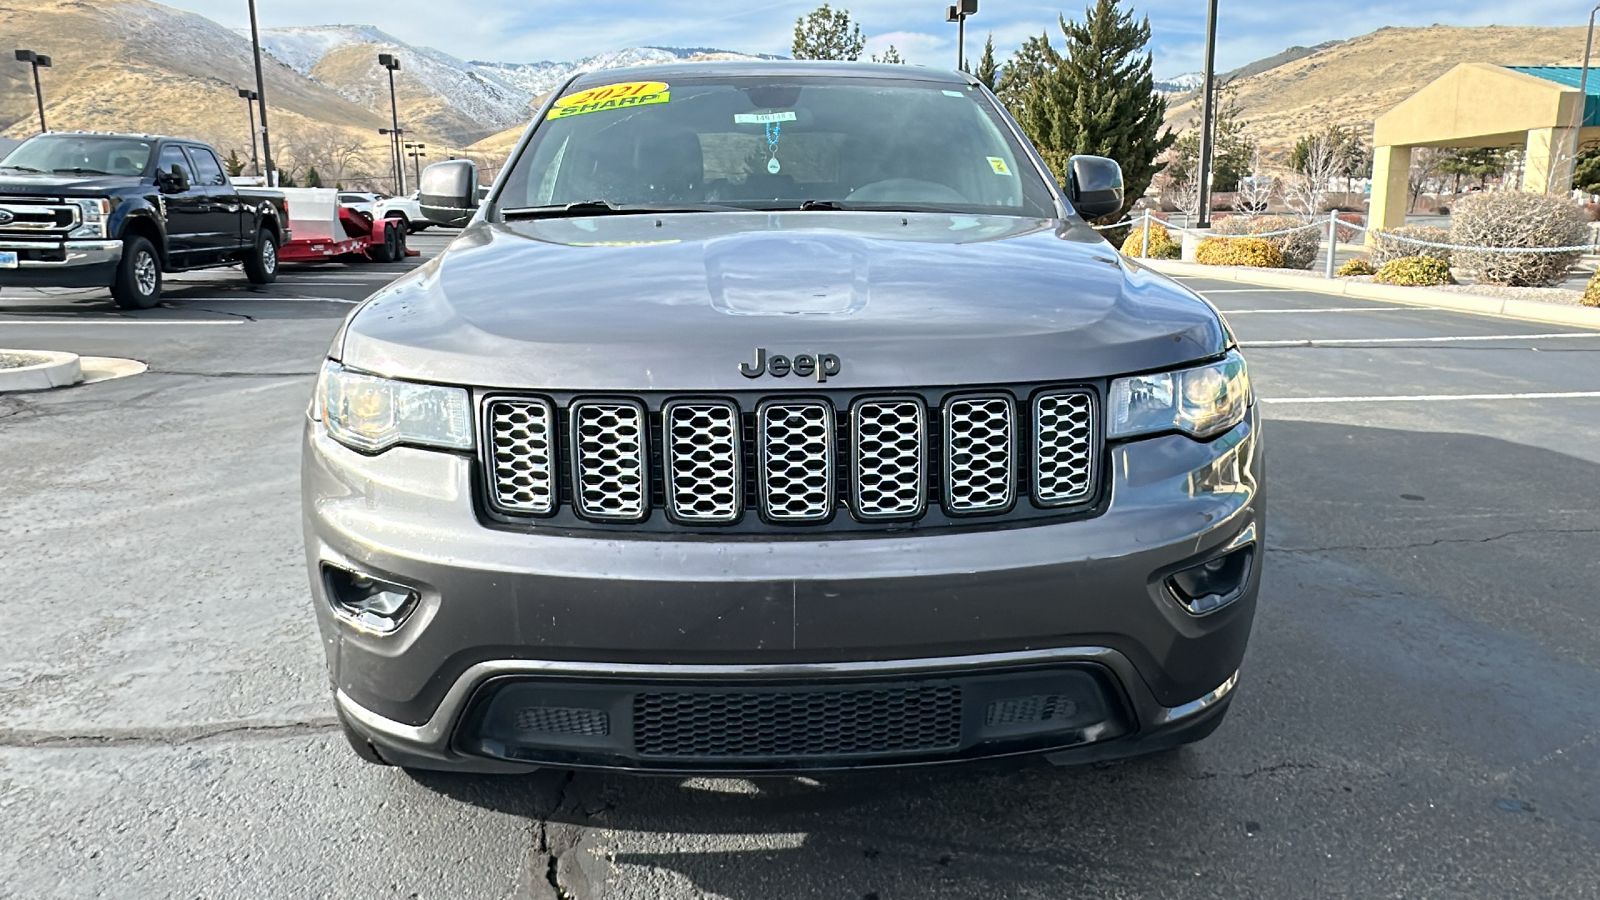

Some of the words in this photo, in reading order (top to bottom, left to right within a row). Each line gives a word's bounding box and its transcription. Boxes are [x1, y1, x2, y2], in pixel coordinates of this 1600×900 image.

[560, 94, 659, 116] SHARP
[573, 84, 648, 105] 2021
[738, 348, 841, 383] Jeep
